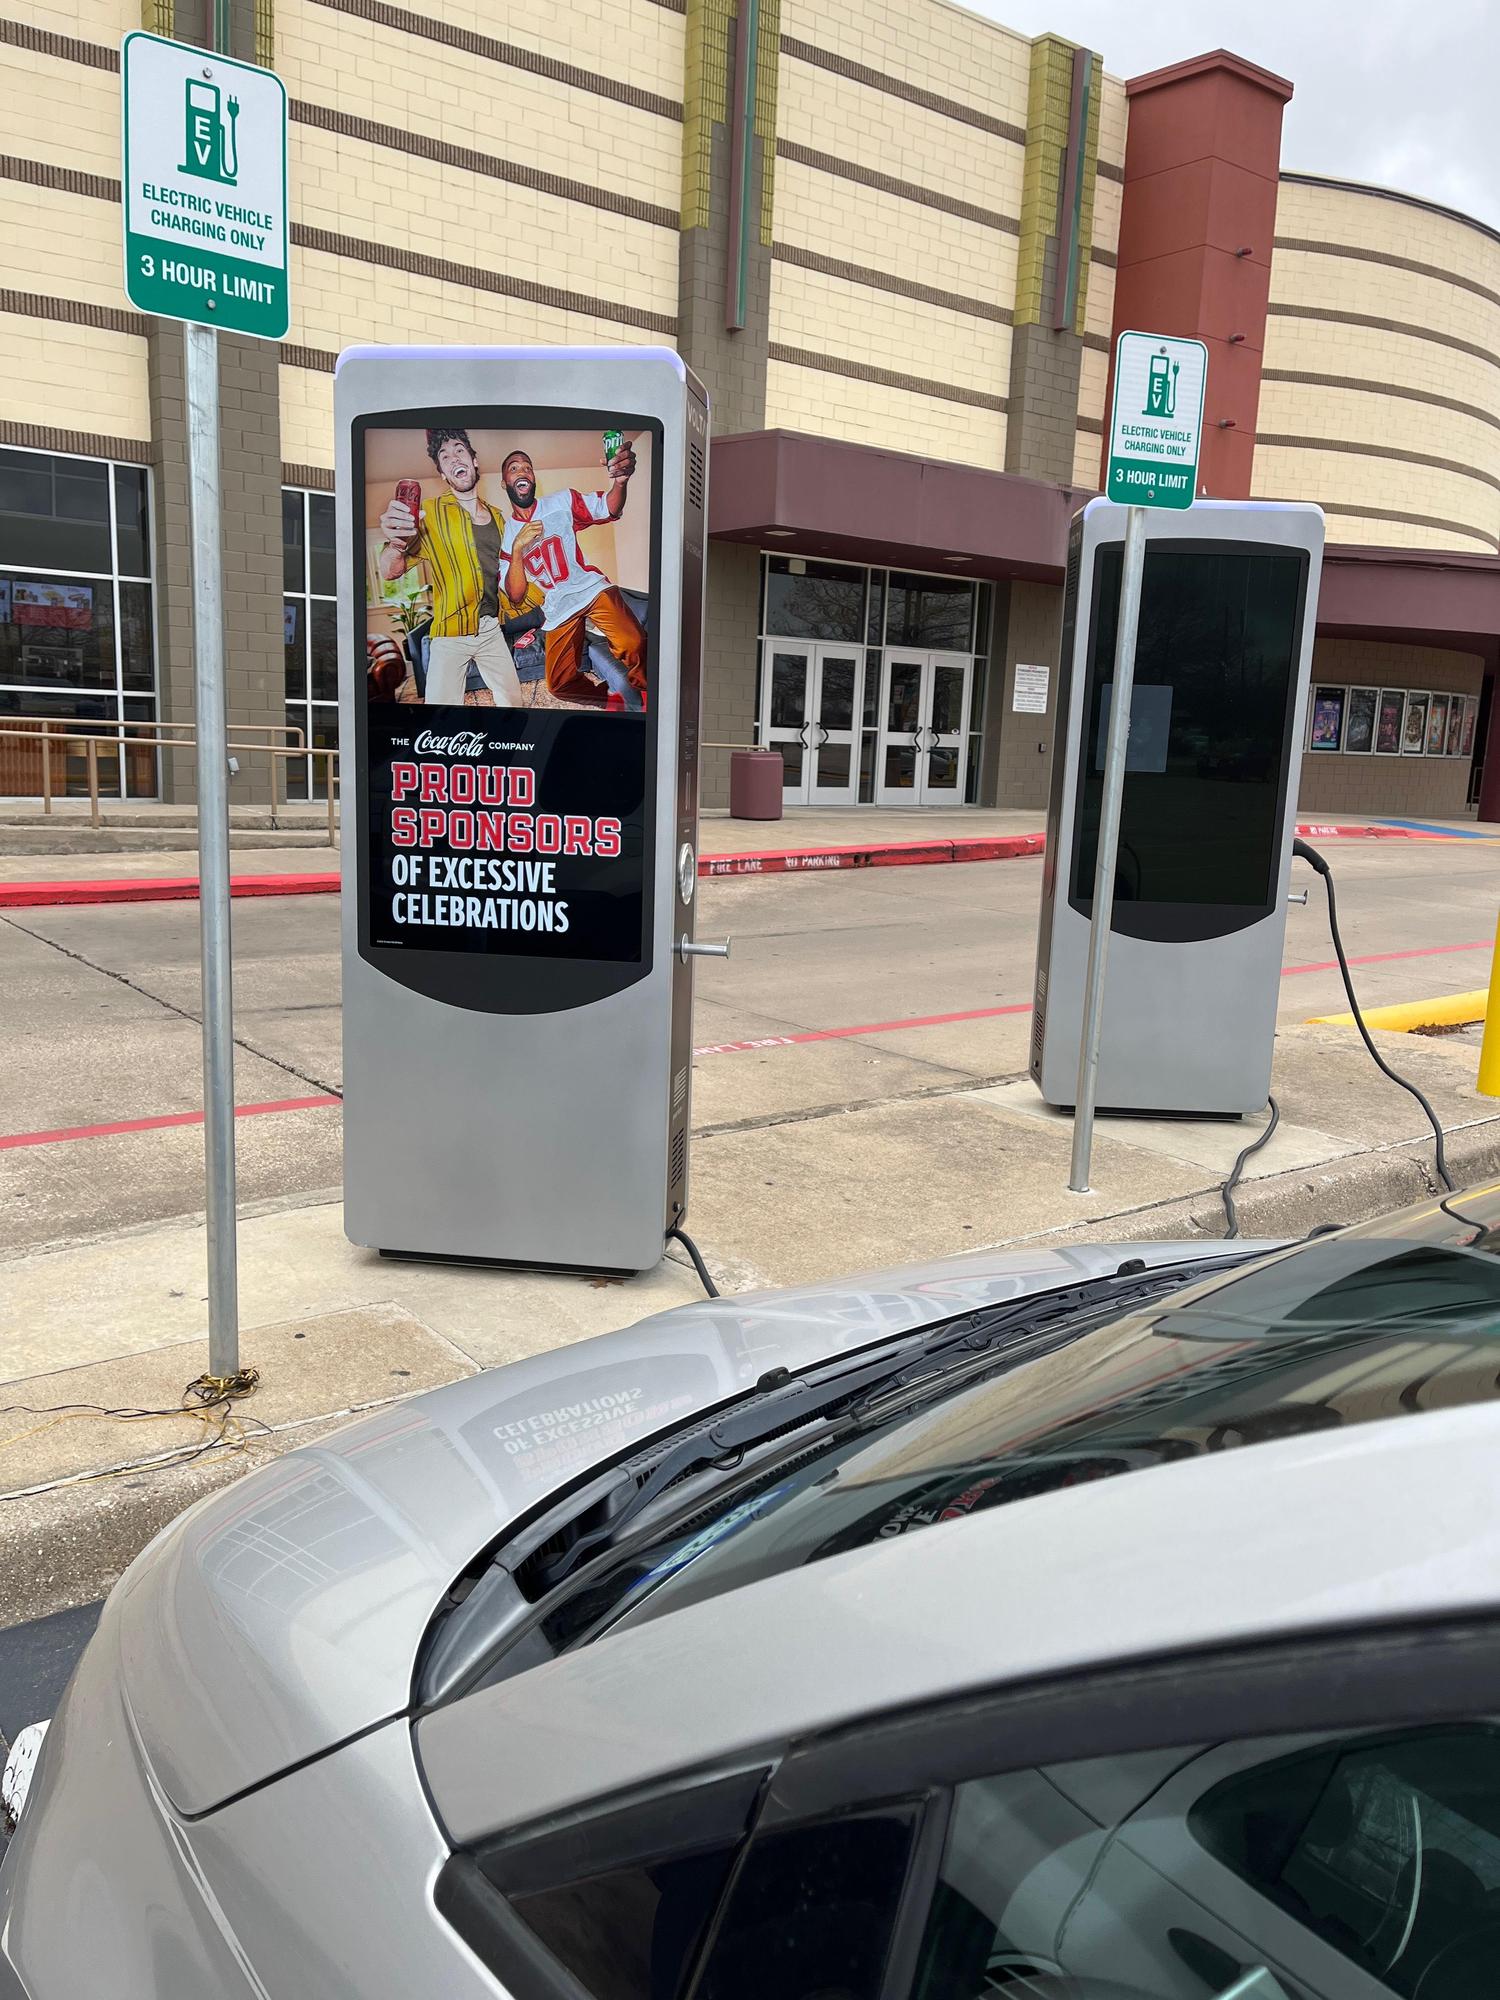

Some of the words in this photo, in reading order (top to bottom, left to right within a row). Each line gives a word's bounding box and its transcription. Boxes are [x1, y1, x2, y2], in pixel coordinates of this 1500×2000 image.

[142, 183, 212, 214] ELECTRIC
[215, 201, 273, 230] VEHICLE
[151, 209, 226, 241] CHARGING
[230, 229, 265, 251] ONLY
[141, 254, 155, 277] 3
[162, 258, 217, 292] HOUR
[223, 273, 275, 305] LIMIT
[1121, 424, 1158, 439] ELECTRIC
[1160, 429, 1192, 443] VEHICLE
[1124, 440, 1165, 454] CHARGING
[1166, 445, 1187, 456] ONLY
[1116, 468, 1124, 482] 3
[1126, 470, 1156, 486] HOUR
[1158, 473, 1189, 489] LIMIT
[391, 737, 410, 747] THE
[488, 741, 535, 751] COMPANY
[391, 762, 536, 807] PROUD
[391, 807, 622, 858] SPONSORS
[391, 854, 423, 887] OF
[429, 856, 556, 894] EXCESSIVE
[802, 855, 840, 868] PARKING
[392, 892, 570, 933] CELEBRATIONS
